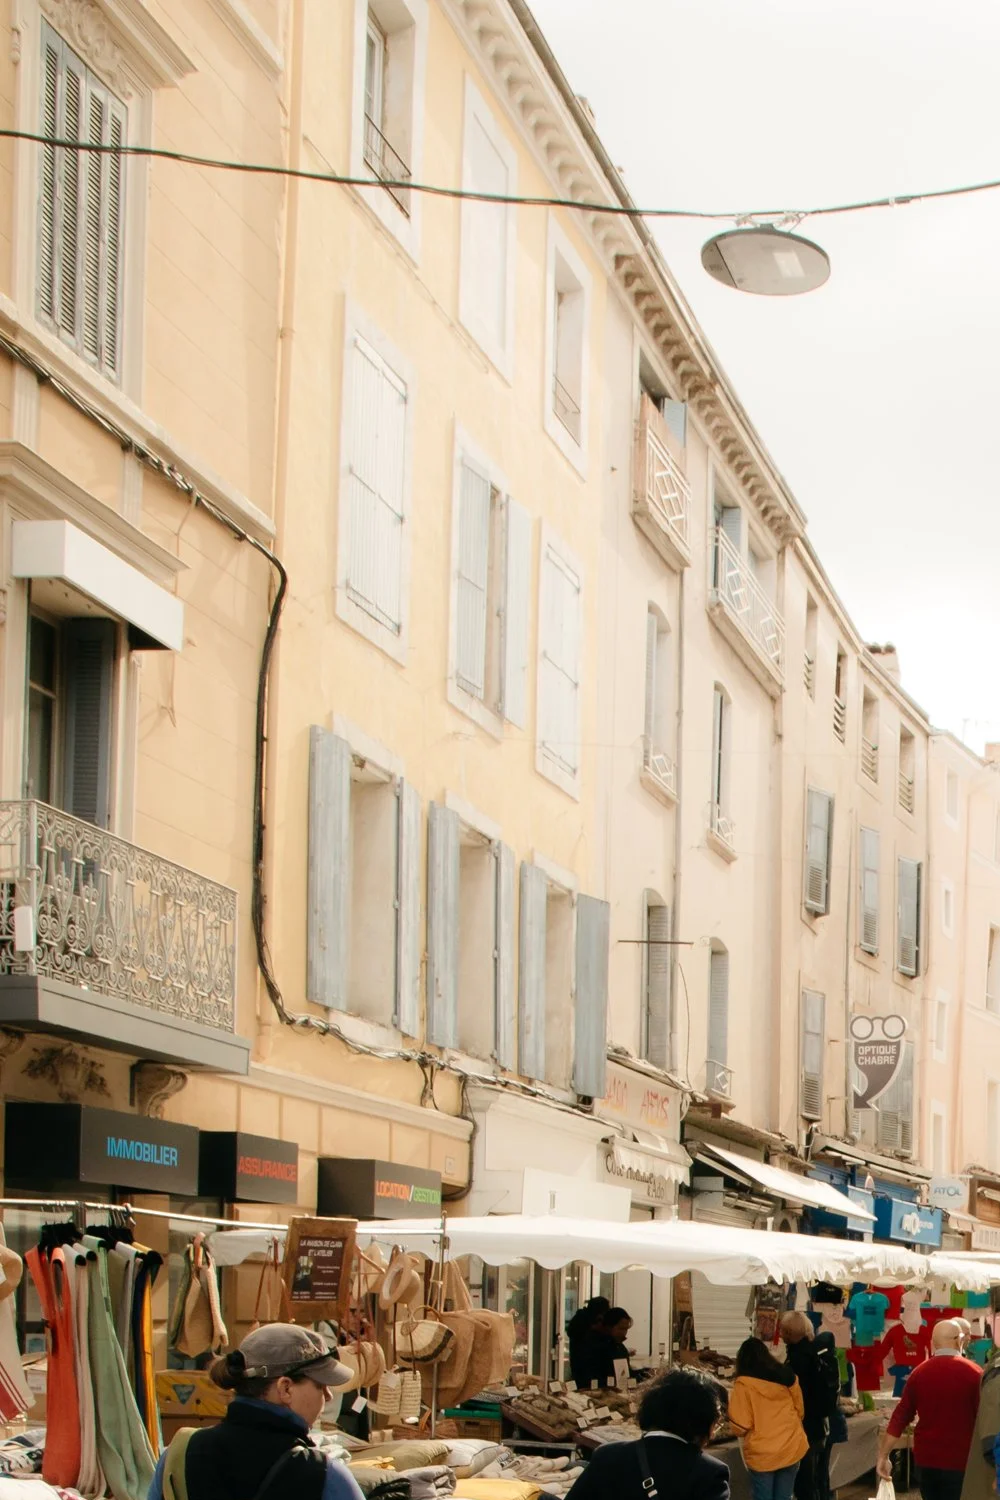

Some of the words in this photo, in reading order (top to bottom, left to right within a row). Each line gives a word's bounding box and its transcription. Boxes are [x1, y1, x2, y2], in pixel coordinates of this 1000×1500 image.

[858, 1045, 897, 1056] OPTIQUE
[857, 1055, 895, 1066] CHABRE
[106, 1136, 179, 1167] IMMOBILIER
[237, 1156, 297, 1182] ASSURANCE
[934, 1186, 962, 1197] ATOL
